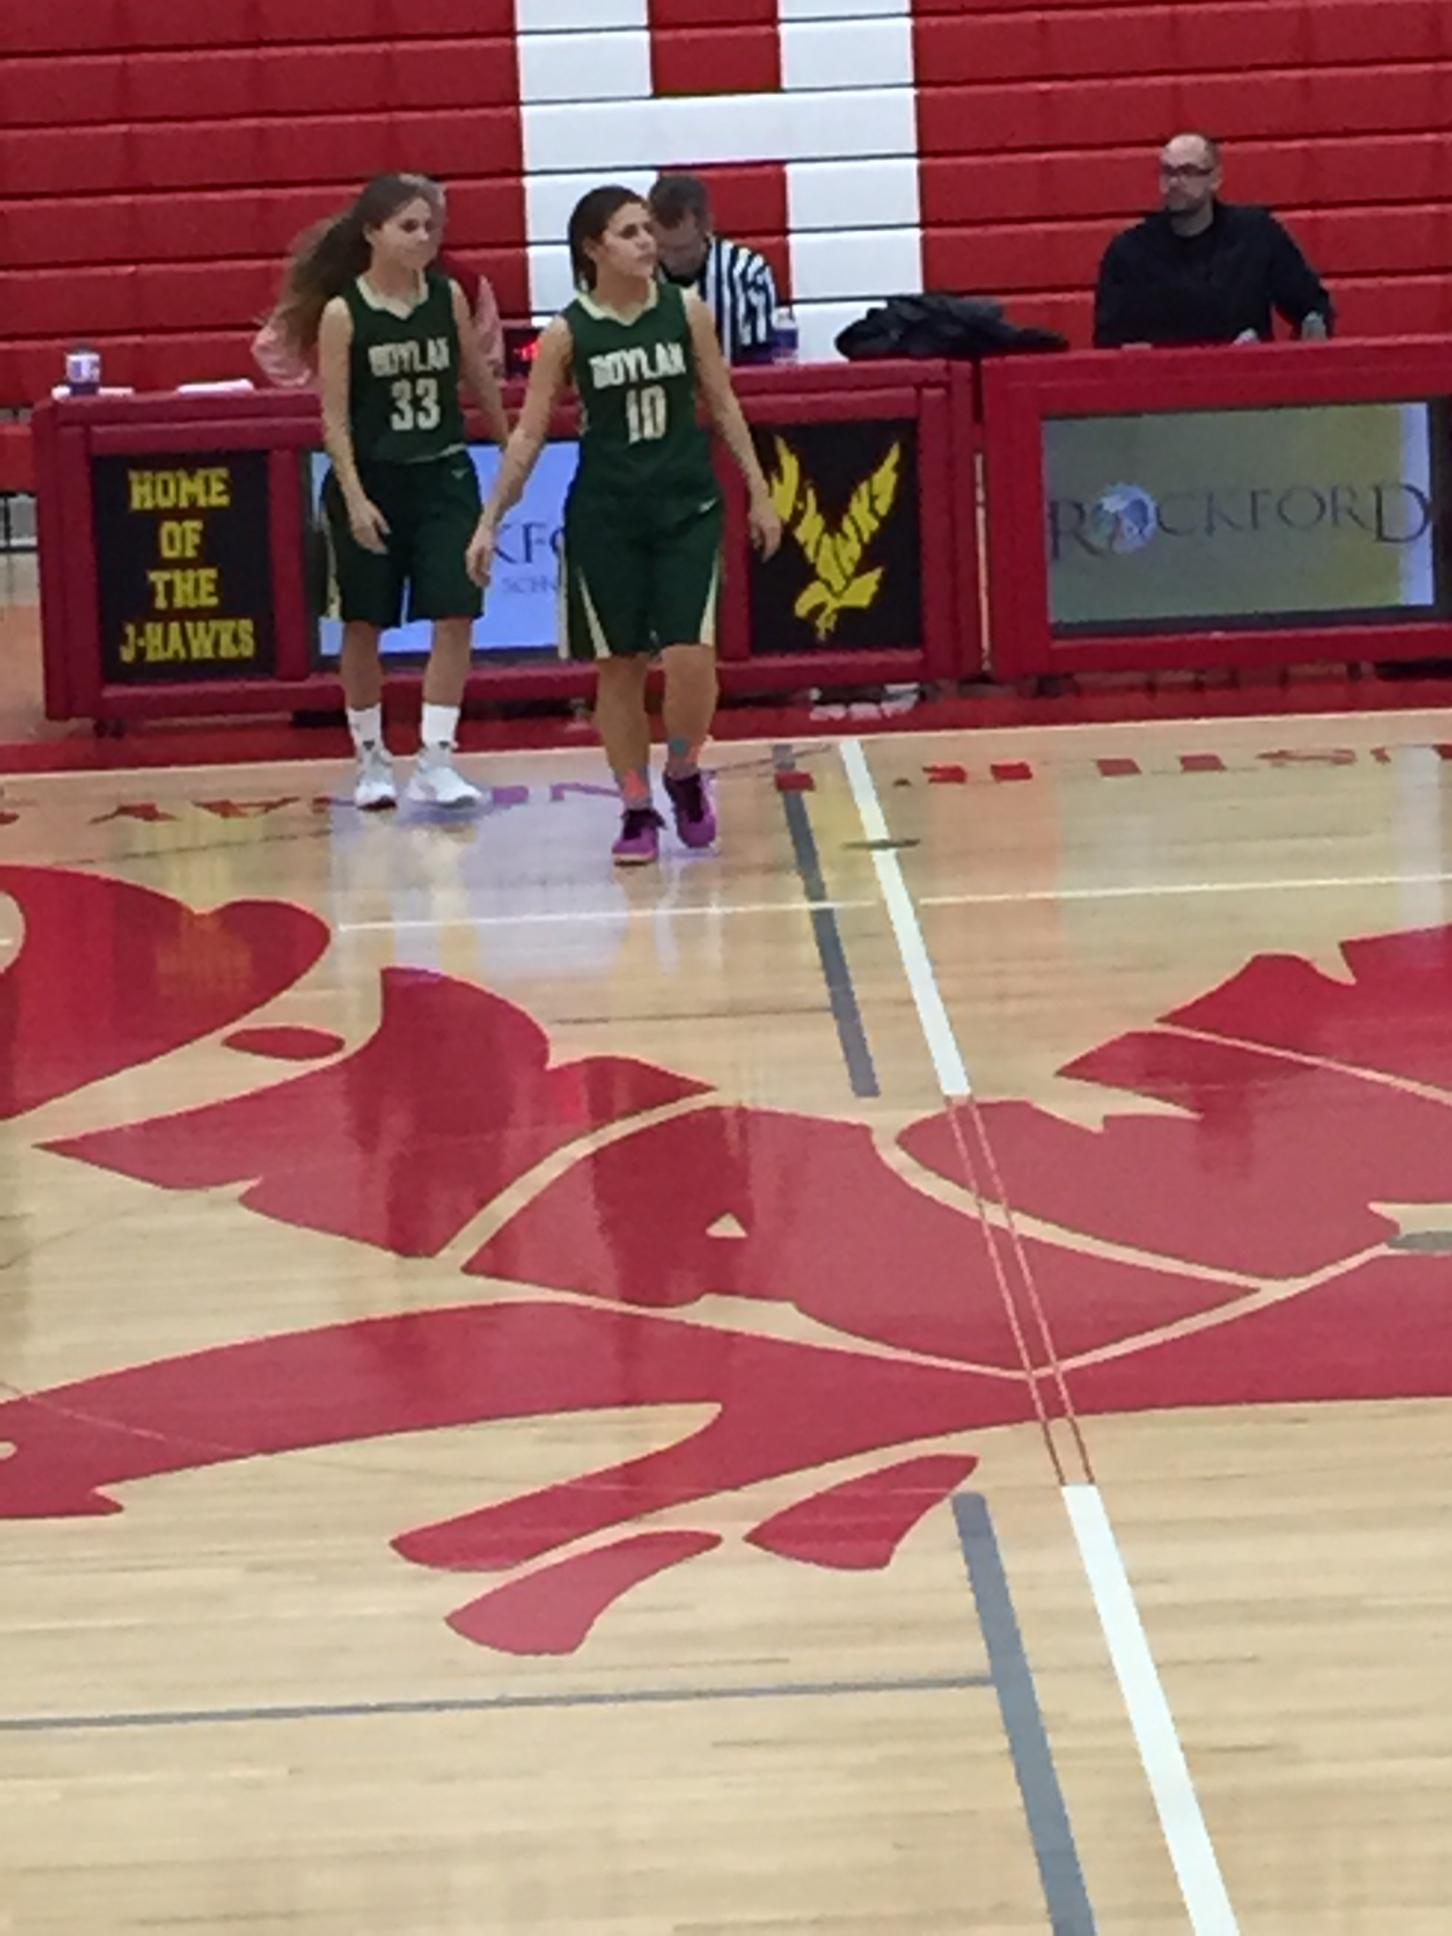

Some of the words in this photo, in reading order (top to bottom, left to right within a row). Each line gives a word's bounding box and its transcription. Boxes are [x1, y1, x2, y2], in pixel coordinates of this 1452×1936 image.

[368, 337, 450, 377] BOYLAN
[589, 343, 686, 389] BOYLAN
[391, 378, 441, 431] 33
[626, 386, 668, 443] 10
[128, 467, 231, 512] HOME
[160, 520, 204, 559] OF
[147, 568, 220, 610] THE
[119, 618, 255, 664] J-HAWKS
